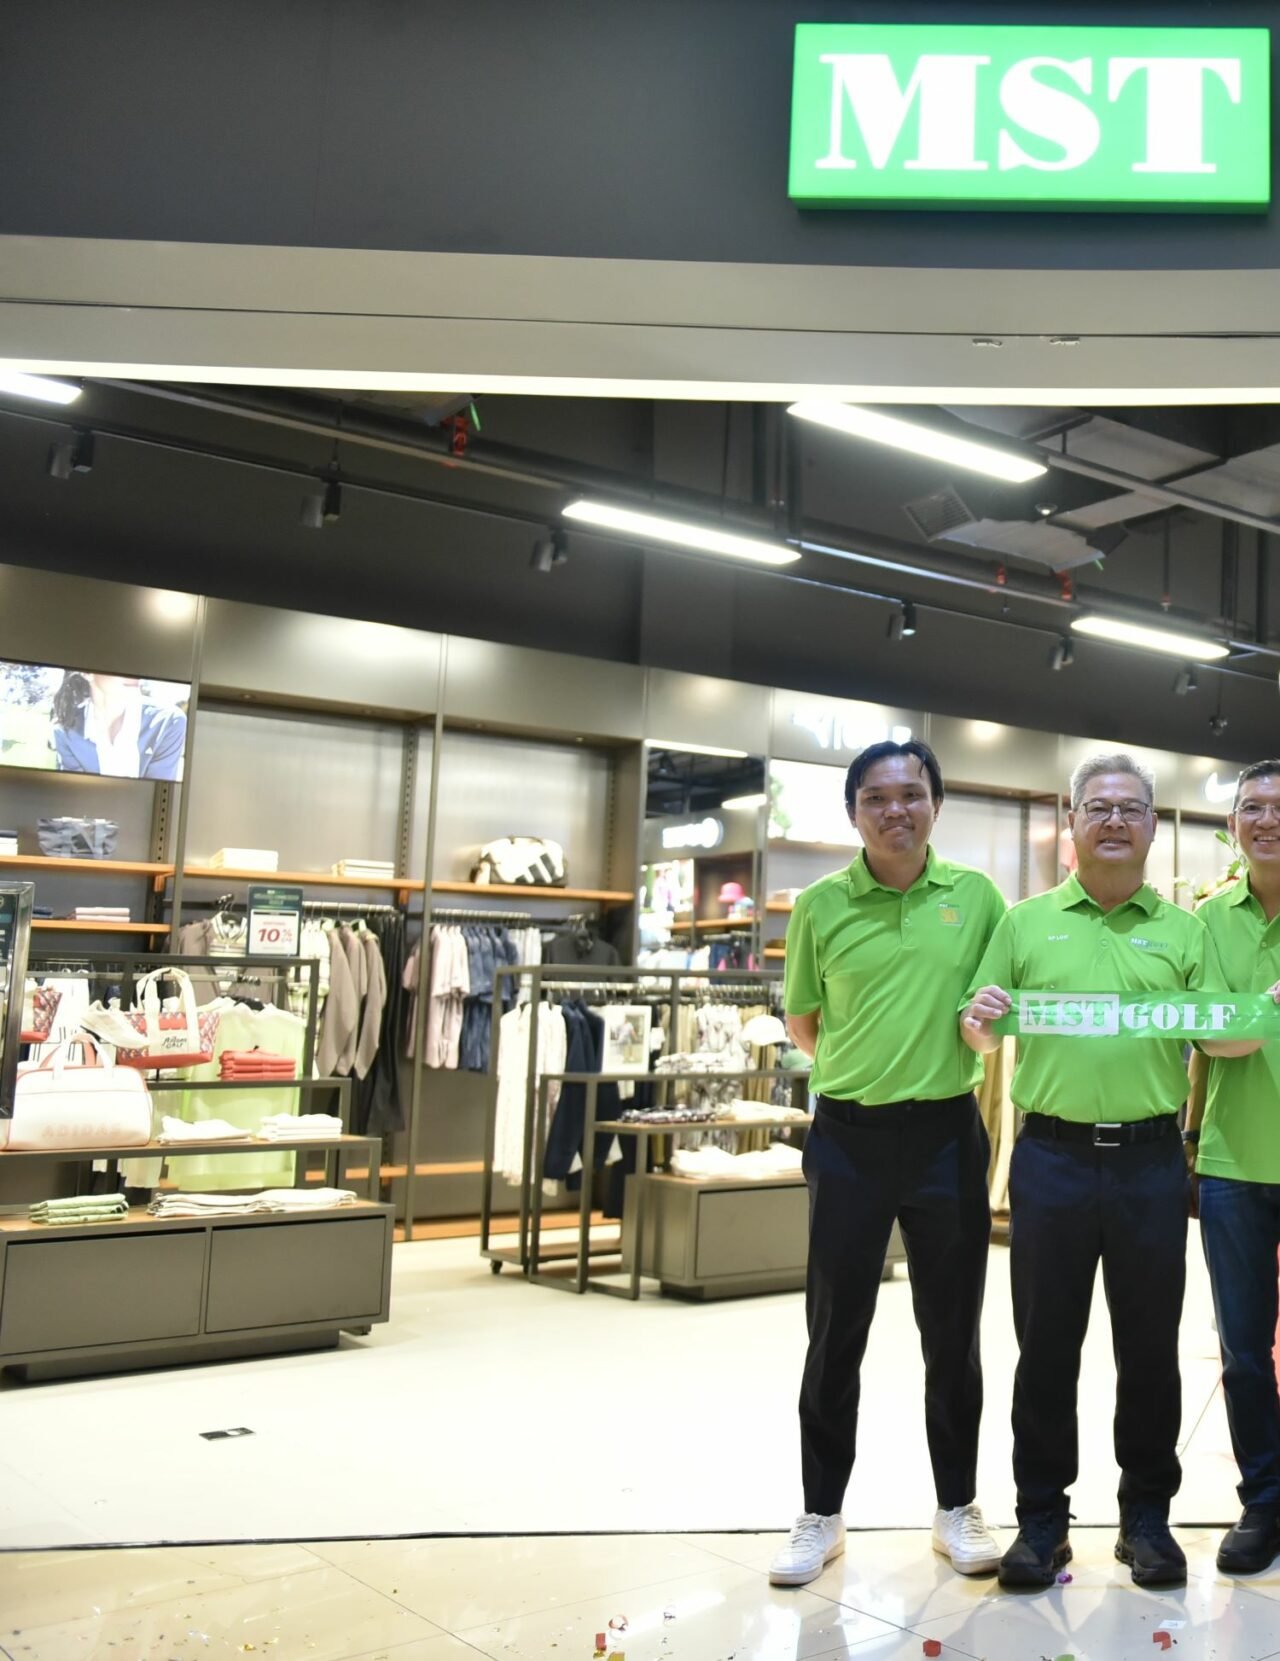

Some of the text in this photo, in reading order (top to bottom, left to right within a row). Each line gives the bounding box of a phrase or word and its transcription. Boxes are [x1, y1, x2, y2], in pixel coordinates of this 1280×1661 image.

[815, 53, 1241, 173] MST
[1023, 998, 1236, 1031] MST GOLF
